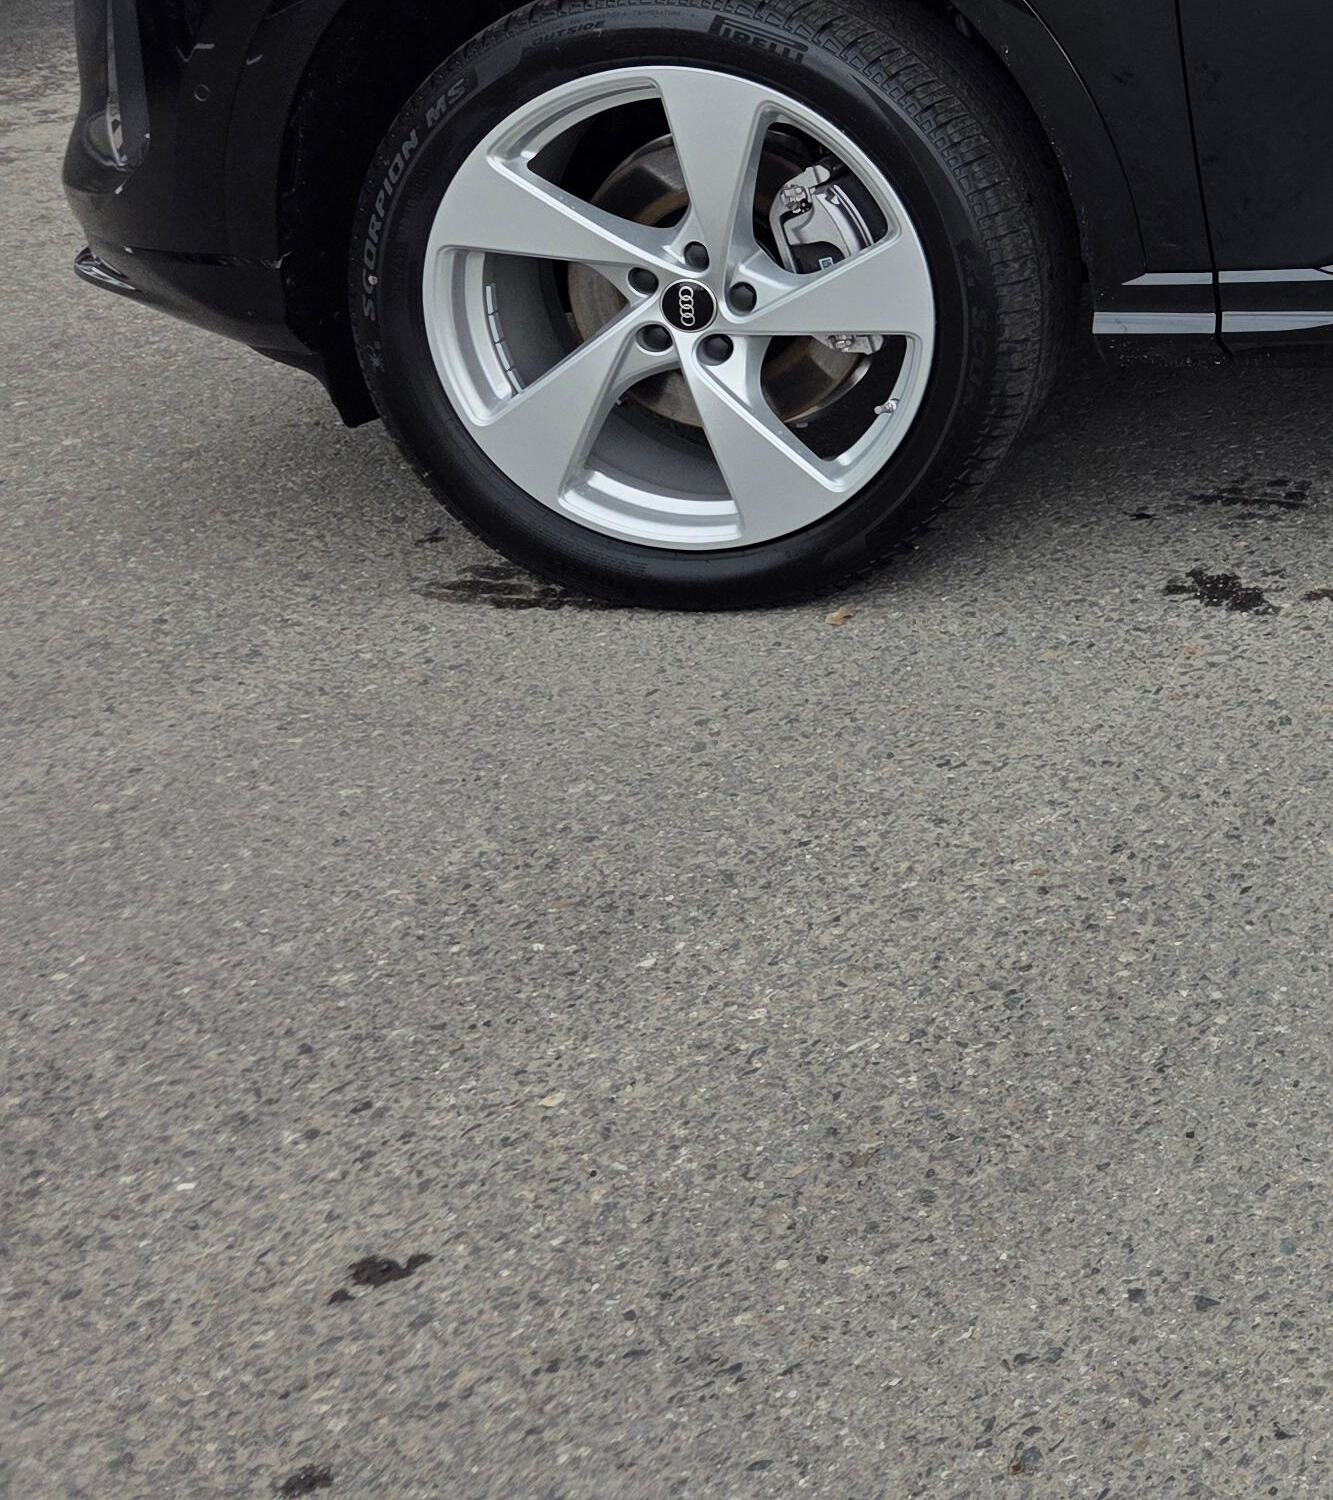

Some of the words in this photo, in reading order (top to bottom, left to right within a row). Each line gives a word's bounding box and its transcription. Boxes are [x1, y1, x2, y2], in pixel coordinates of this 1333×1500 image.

[708, 14, 809, 64] PIRELLI
[363, 129, 419, 321] SCORPION
[426, 78, 466, 128] MS
